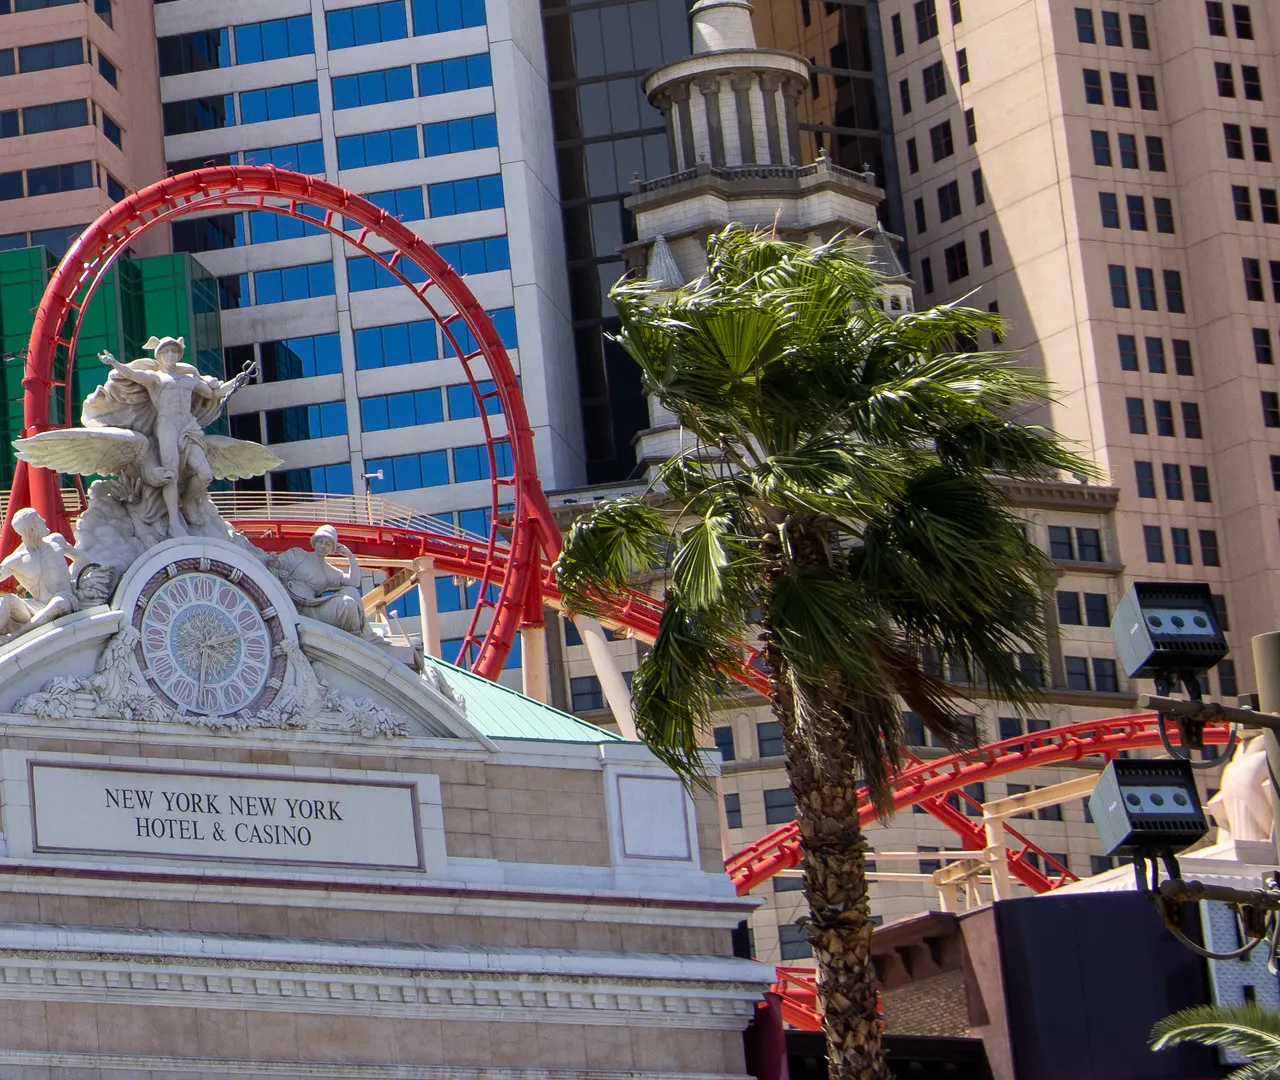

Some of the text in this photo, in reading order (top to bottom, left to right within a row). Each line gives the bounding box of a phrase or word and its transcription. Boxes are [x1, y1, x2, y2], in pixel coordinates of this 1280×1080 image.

[104, 788, 345, 821] NEW YORK NEW YORK
[135, 816, 312, 847] HOTEL & CASINO
